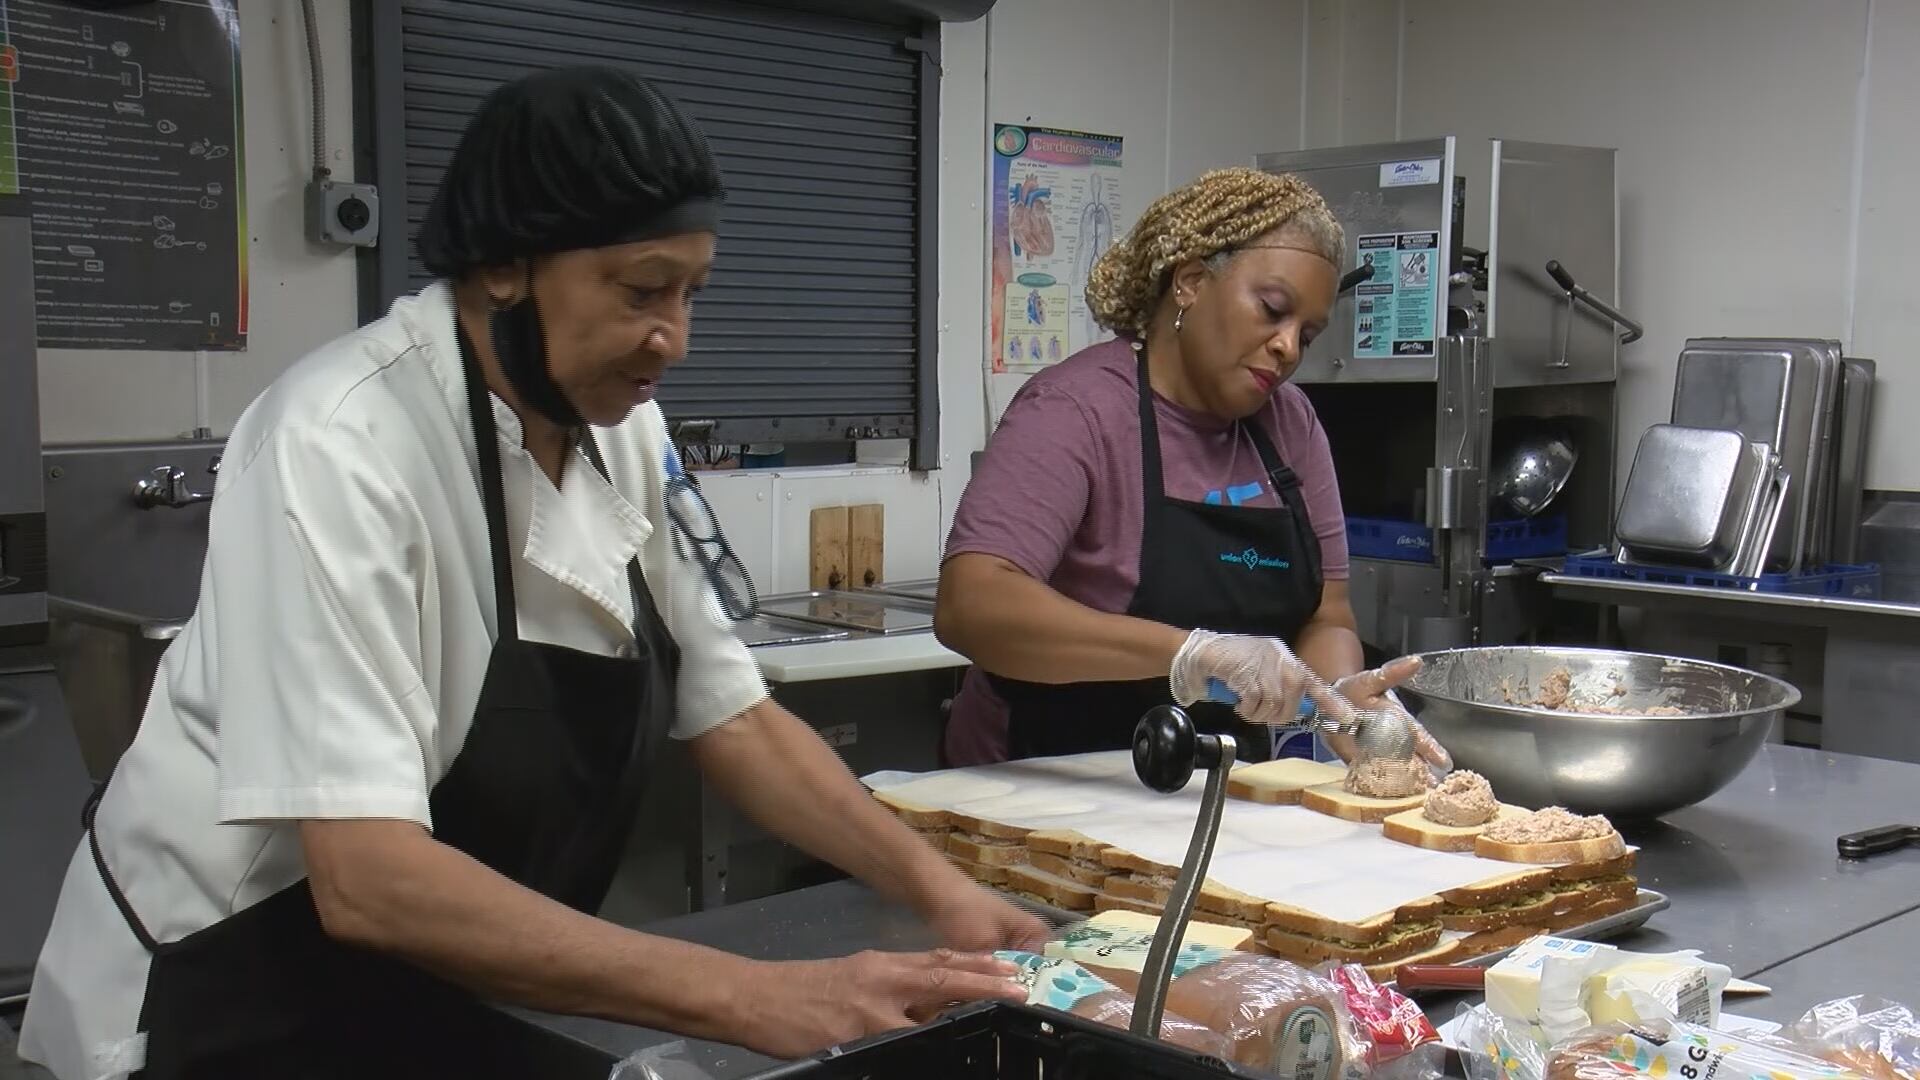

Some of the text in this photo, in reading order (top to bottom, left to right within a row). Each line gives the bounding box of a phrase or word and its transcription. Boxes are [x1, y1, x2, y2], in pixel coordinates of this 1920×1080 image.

[1032, 137, 1120, 158] Cardiovascular
[1680, 1064, 1698, 1080] 8
[1703, 1053, 1724, 1080] ndwi
